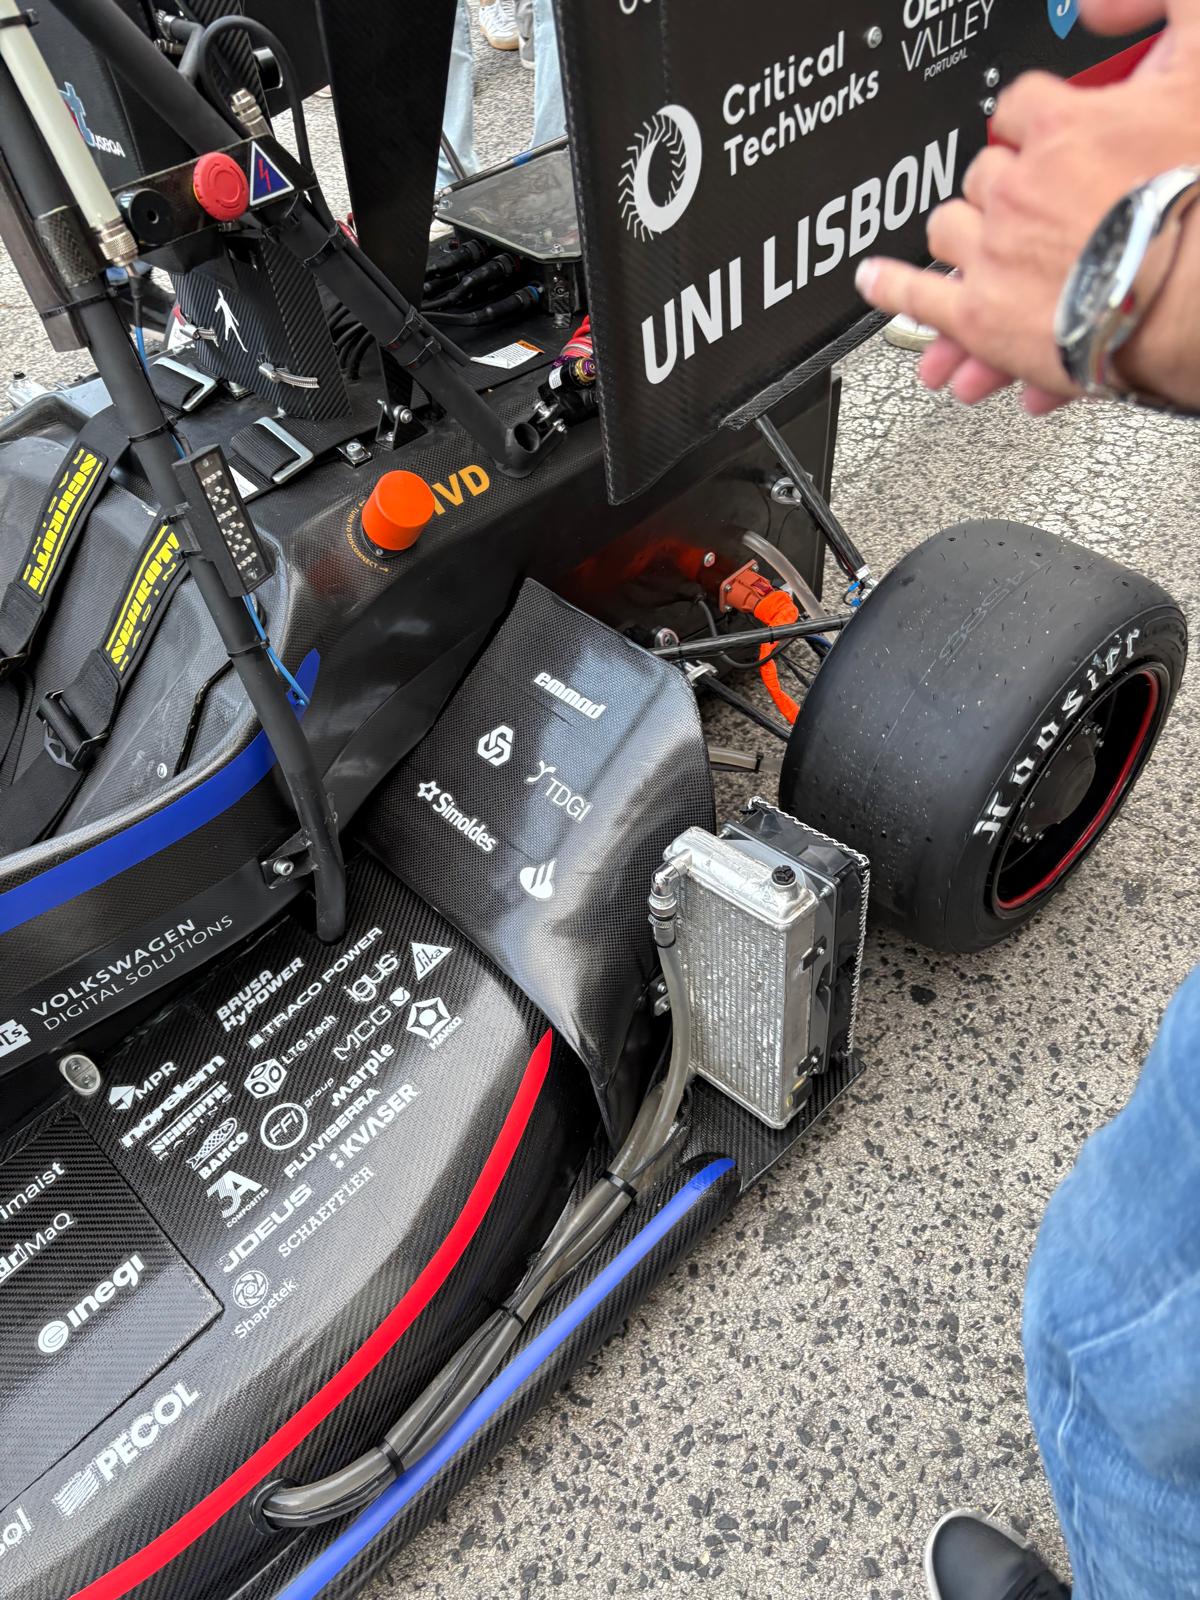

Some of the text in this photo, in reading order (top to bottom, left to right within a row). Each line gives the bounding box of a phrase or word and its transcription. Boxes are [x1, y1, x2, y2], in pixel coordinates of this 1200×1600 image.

[901, 0, 995, 72] VALLEY
[722, 30, 845, 126] Critical
[923, 47, 968, 82] PORTUGAL
[641, 127, 959, 386] UNI LISBON
[347, 506, 360, 524] TURN
[346, 533, 379, 569] DISCONNECT
[533, 671, 607, 720] emmad
[972, 627, 1141, 845] Hoosier
[432, 792, 496, 852] Simoldes
[545, 777, 593, 822] TDGI
[30, 918, 196, 1017] VOLKSWAGEN
[43, 914, 233, 1031] DIGITAL SOLUTIONS
[261, 927, 384, 1035] TRACO POWER
[343, 953, 398, 1003] igus
[415, 948, 443, 974] Sika
[216, 969, 274, 1023] BRUSA
[222, 957, 305, 1034] HyPOWER
[281, 1014, 338, 1065] LTG Tech
[333, 1004, 392, 1061] MCG
[428, 1015, 462, 1050] HAKKO
[119, 1055, 226, 1148] norelem
[135, 1061, 177, 1100] MPR
[303, 1077, 335, 1109] group
[198, 1131, 249, 1180] BAHCO
[206, 1169, 263, 1219] 3A
[226, 1187, 270, 1229] COMPOSITES
[277, 1166, 375, 1258] SCHAEFFLER
[222, 1183, 313, 1273] JDEUS
[233, 1278, 297, 1339] Shapetek
[95, 1382, 201, 1482] PECOL
